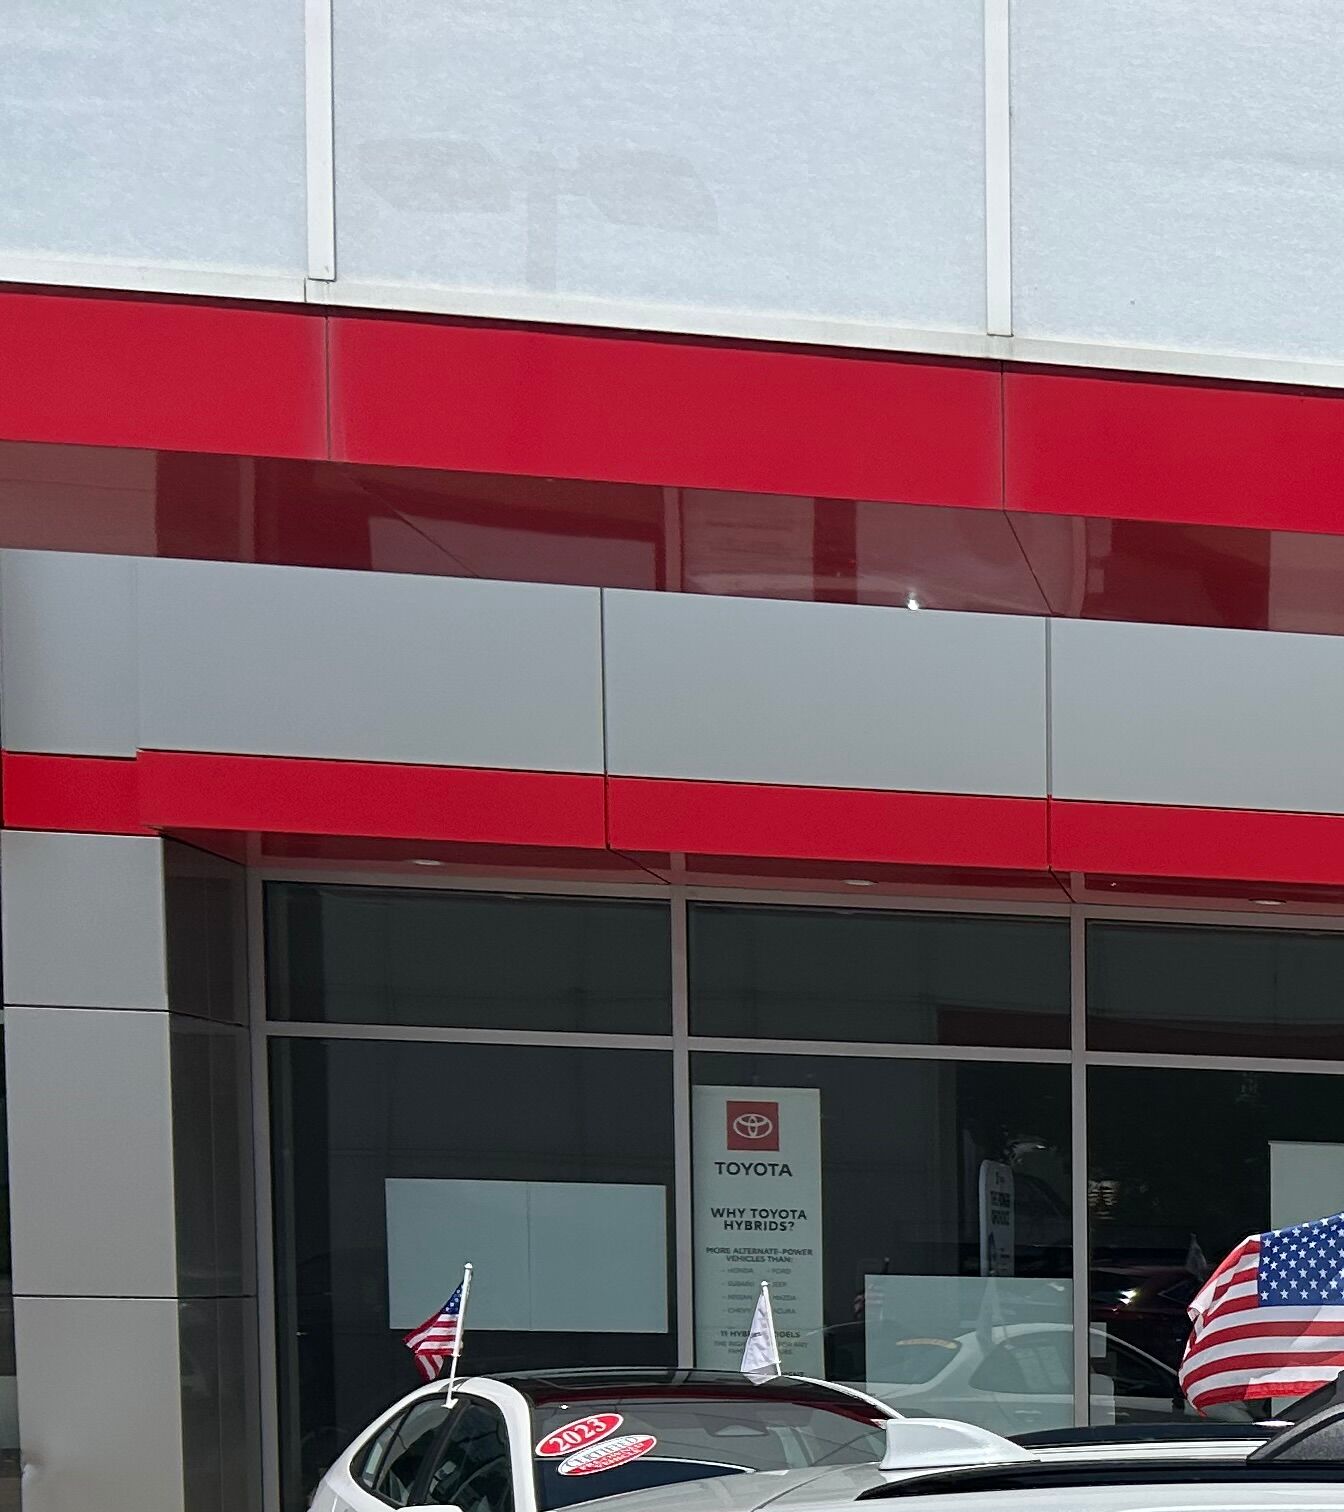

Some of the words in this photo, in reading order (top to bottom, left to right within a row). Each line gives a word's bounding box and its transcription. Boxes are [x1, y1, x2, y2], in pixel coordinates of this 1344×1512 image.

[714, 1161, 793, 1177] TOYOTA
[710, 1207, 746, 1219] WHY
[750, 1208, 807, 1220] TOYOTA
[723, 1220, 795, 1232] HYBRIDS?
[706, 1246, 731, 1255] MORE
[549, 1417, 608, 1452] 2023
[566, 1435, 640, 1468] CERTIFIED
